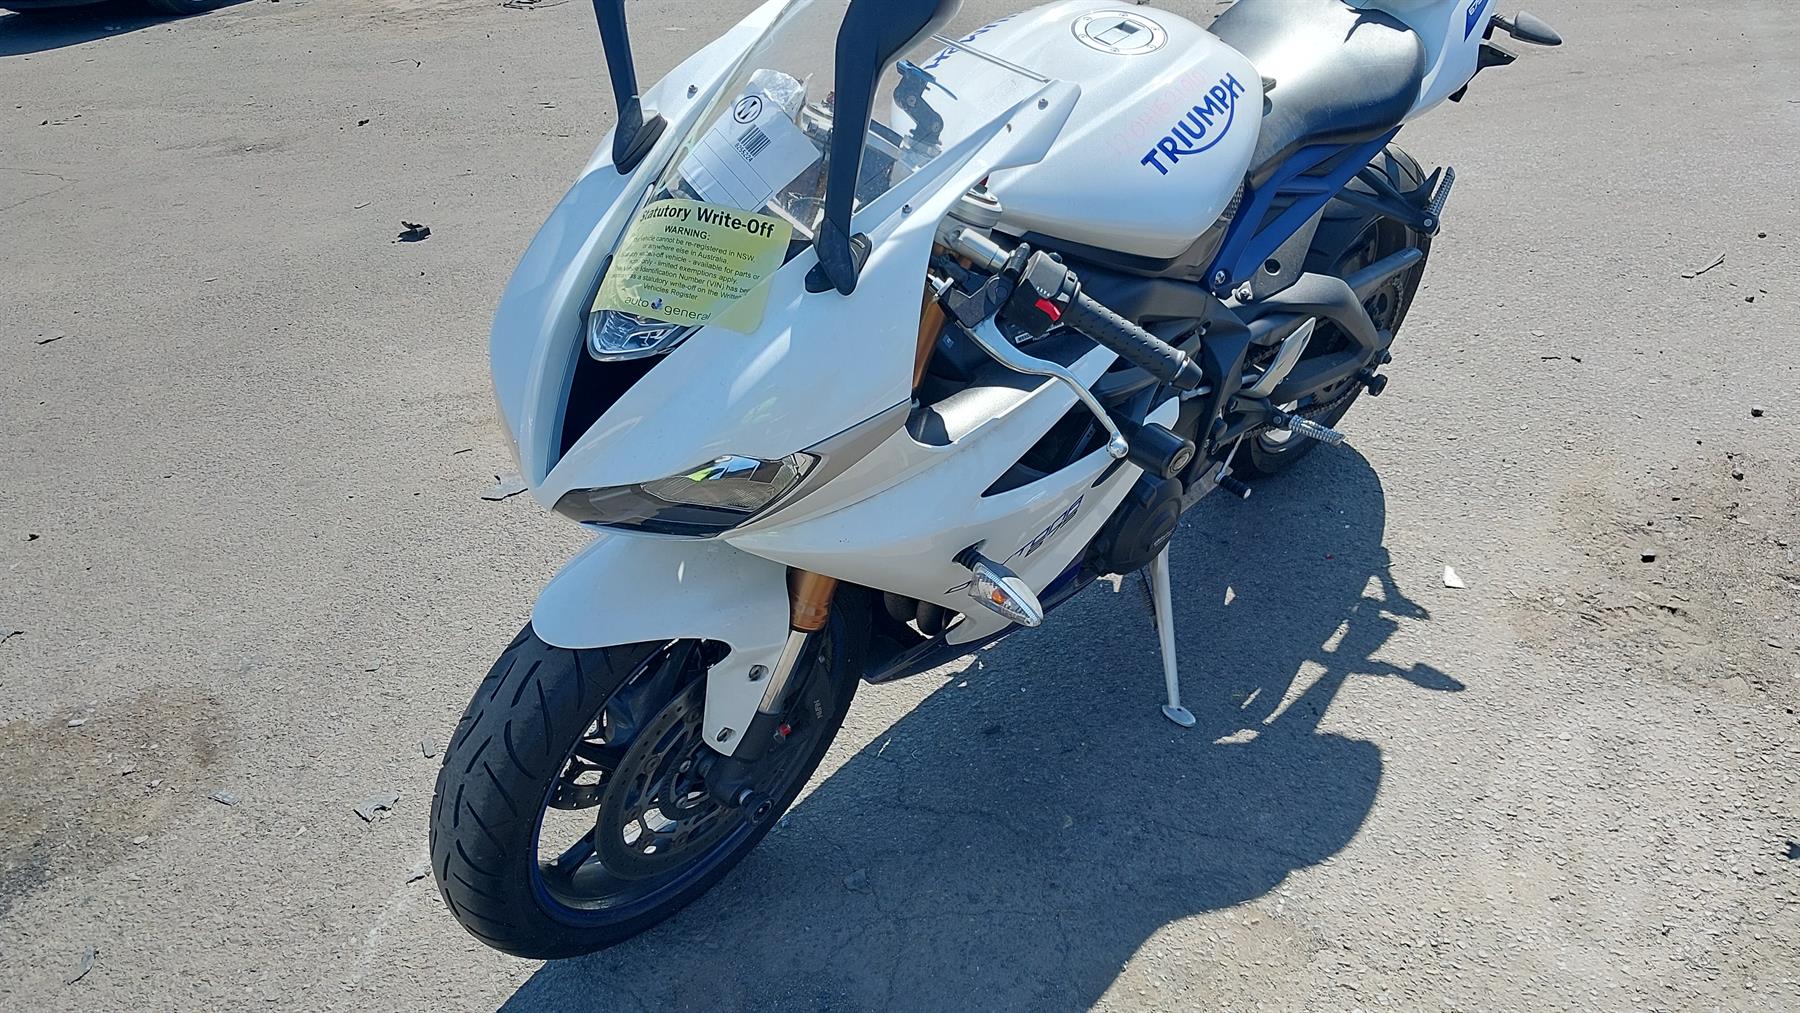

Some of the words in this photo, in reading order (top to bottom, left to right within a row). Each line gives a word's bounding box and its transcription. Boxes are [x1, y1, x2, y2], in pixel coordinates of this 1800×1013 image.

[1140, 72, 1245, 175] TRIUMPH
[640, 204, 692, 222] Statutory
[697, 206, 774, 238] Write-Off
[664, 225, 710, 240] WARNING:
[656, 236, 675, 244] cannot
[676, 237, 684, 245] be
[685, 240, 728, 254] re-registered
[736, 252, 755, 263] NSW.
[676, 246, 689, 254] else
[691, 248, 696, 256] in
[698, 251, 728, 264] Australia.
[640, 266, 677, 278] Identification
[678, 273, 705, 284] Number
[706, 279, 725, 290] (VIN)
[658, 260, 678, 270] limited
[678, 266, 717, 278] exemptions
[665, 254, 686, 263] vehicle
[692, 260, 722, 271] available
[724, 266, 733, 274] for
[734, 270, 751, 279] parts
[642, 275, 668, 286] statutory
[670, 281, 697, 290] write-off
[708, 288, 718, 296] the
[643, 283, 669, 294] Vehicles
[624, 294, 649, 308] auto
[664, 305, 712, 322] general
